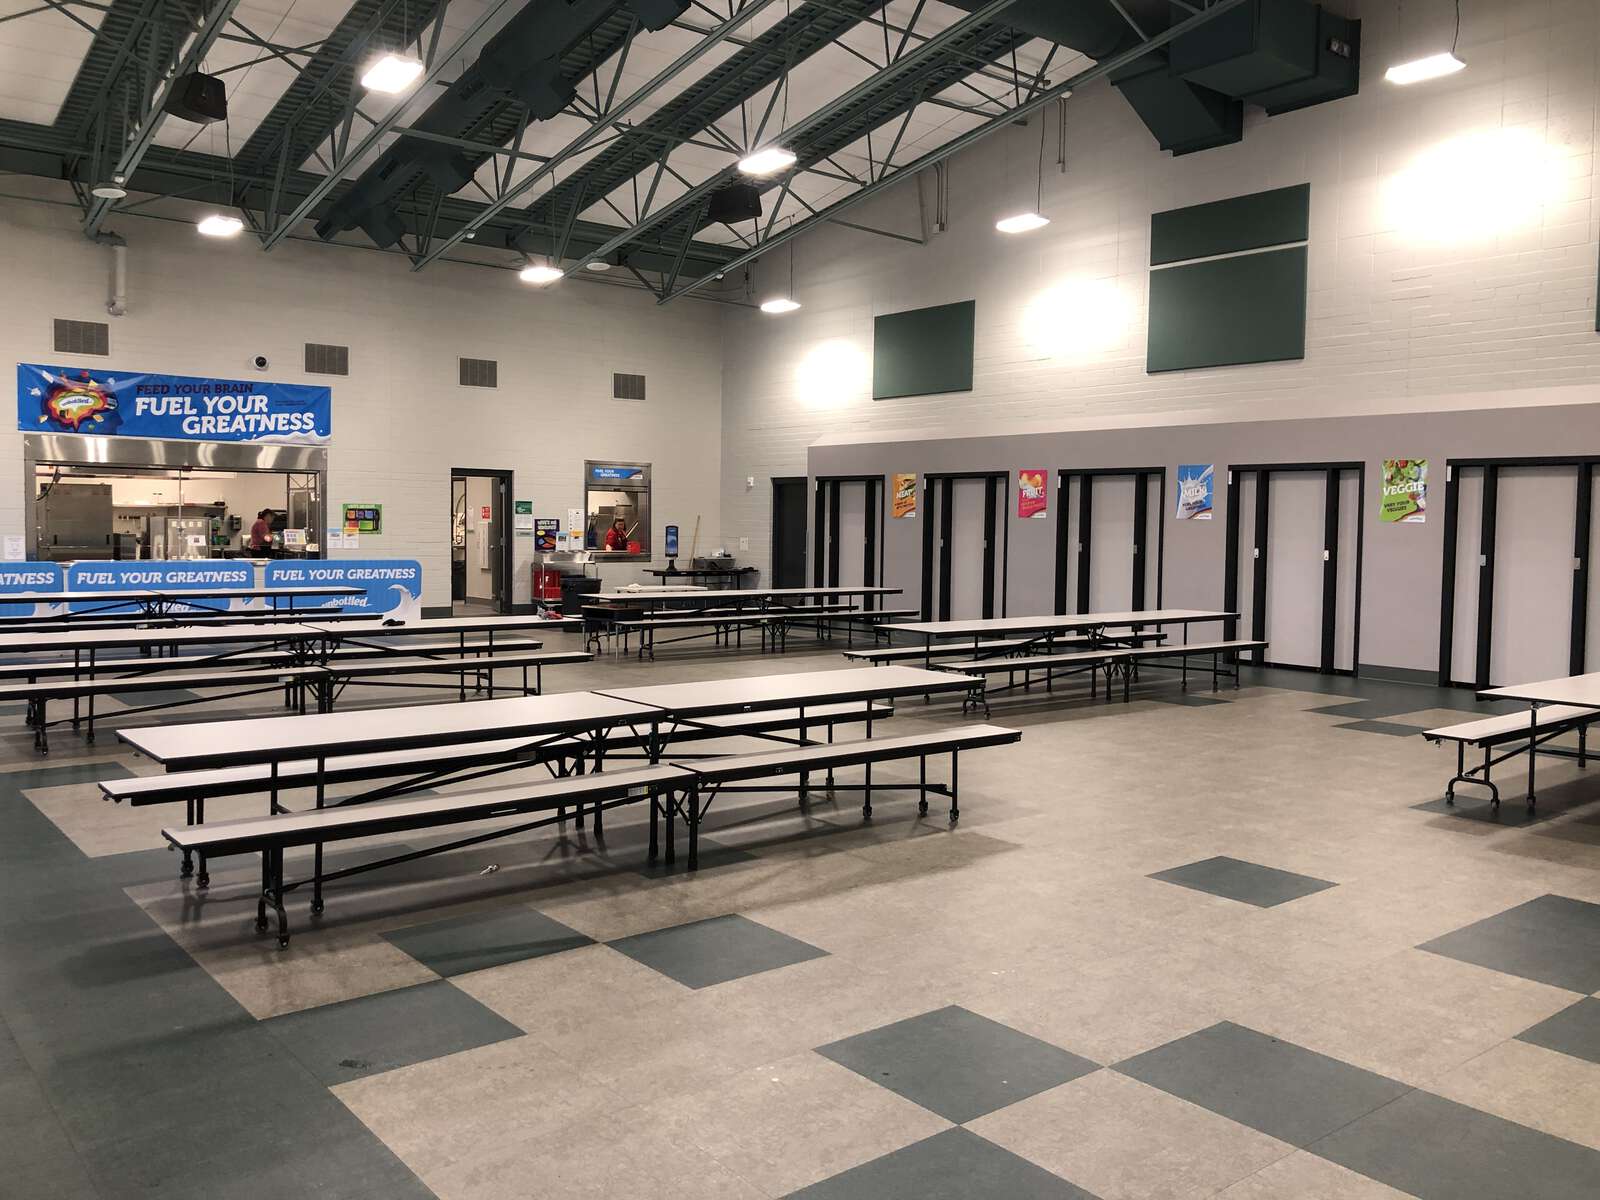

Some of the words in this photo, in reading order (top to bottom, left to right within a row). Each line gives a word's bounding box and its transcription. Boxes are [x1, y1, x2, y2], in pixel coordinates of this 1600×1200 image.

[136, 385, 170, 395] FEED
[174, 384, 211, 394] YOUR
[214, 384, 253, 394] BRAIN
[135, 397, 197, 416] FUEL
[203, 395, 268, 414] YOUR
[182, 412, 315, 434] GREATNESS
[1022, 486, 1044, 499] FRUIT
[1184, 486, 1206, 497] MILK
[1383, 481, 1425, 496] VEGGIE
[77, 572, 116, 585] FUEL
[120, 572, 162, 584] YOUR
[166, 571, 247, 583] GREATNESS
[272, 569, 305, 581] FUEL
[308, 569, 344, 580] YOUR
[347, 568, 416, 580] GREATNESS
